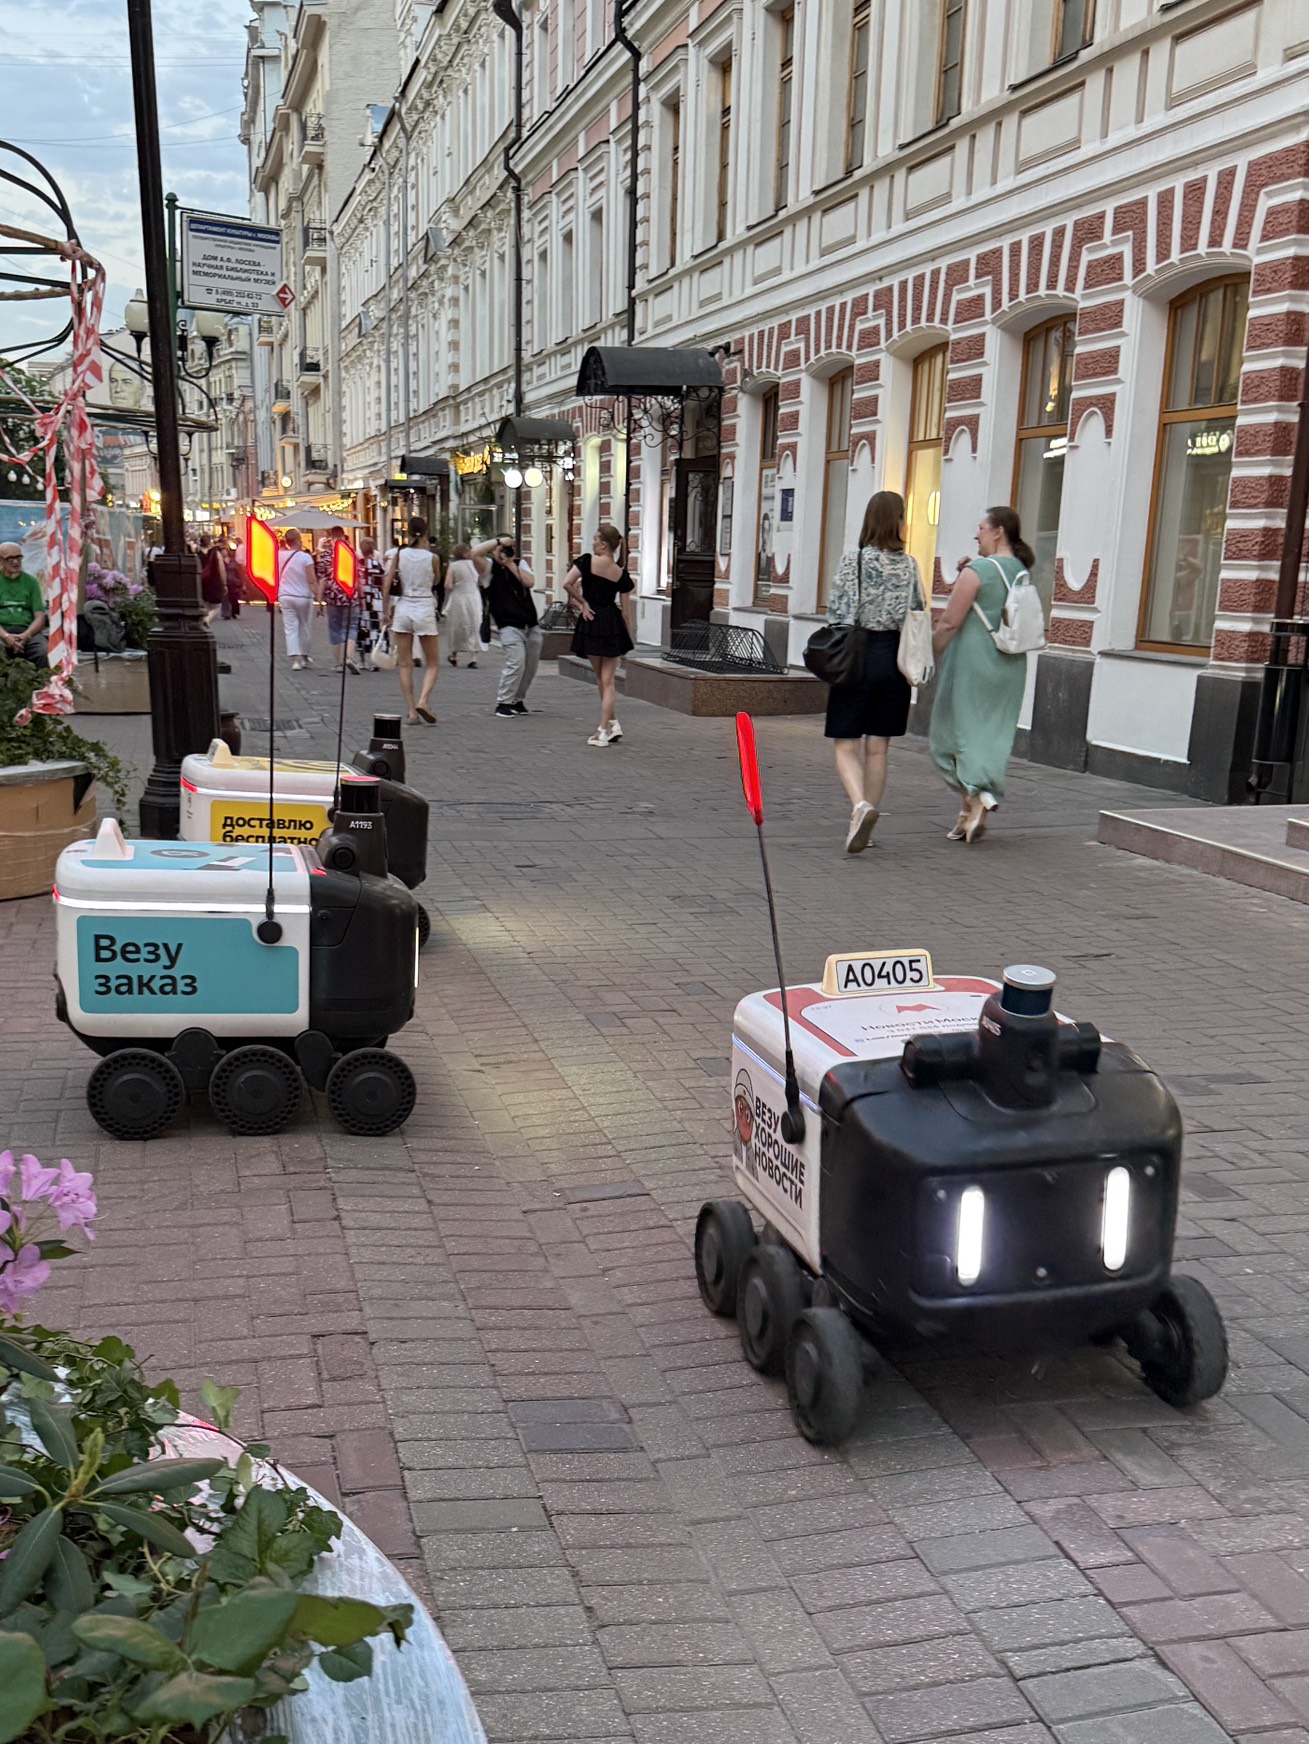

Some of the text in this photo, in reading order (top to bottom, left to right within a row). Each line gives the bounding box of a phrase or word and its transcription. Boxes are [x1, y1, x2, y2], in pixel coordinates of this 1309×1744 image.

[192, 261, 224, 271] НАУЧНАЯ
[226, 266, 268, 277] БИБЛИОТЕКА
[234, 258, 261, 267] ЛОСЕВА
[192, 270, 276, 286] МЕМОРИАЛЬНЫЙ МУЗЕЙ
[222, 816, 314, 831] доставлю
[349, 820, 373, 829] A1193
[93, 933, 184, 970] Везу
[843, 958, 923, 989] A0405
[94, 973, 198, 996] заказ
[861, 1020, 934, 1031] Новости
[935, 1016, 979, 1024] Моск
[755, 1096, 780, 1134] ВЕЗУ
[755, 1118, 805, 1187] ХОРОШИЕ
[754, 1142, 803, 1211] НОВОСТИ
